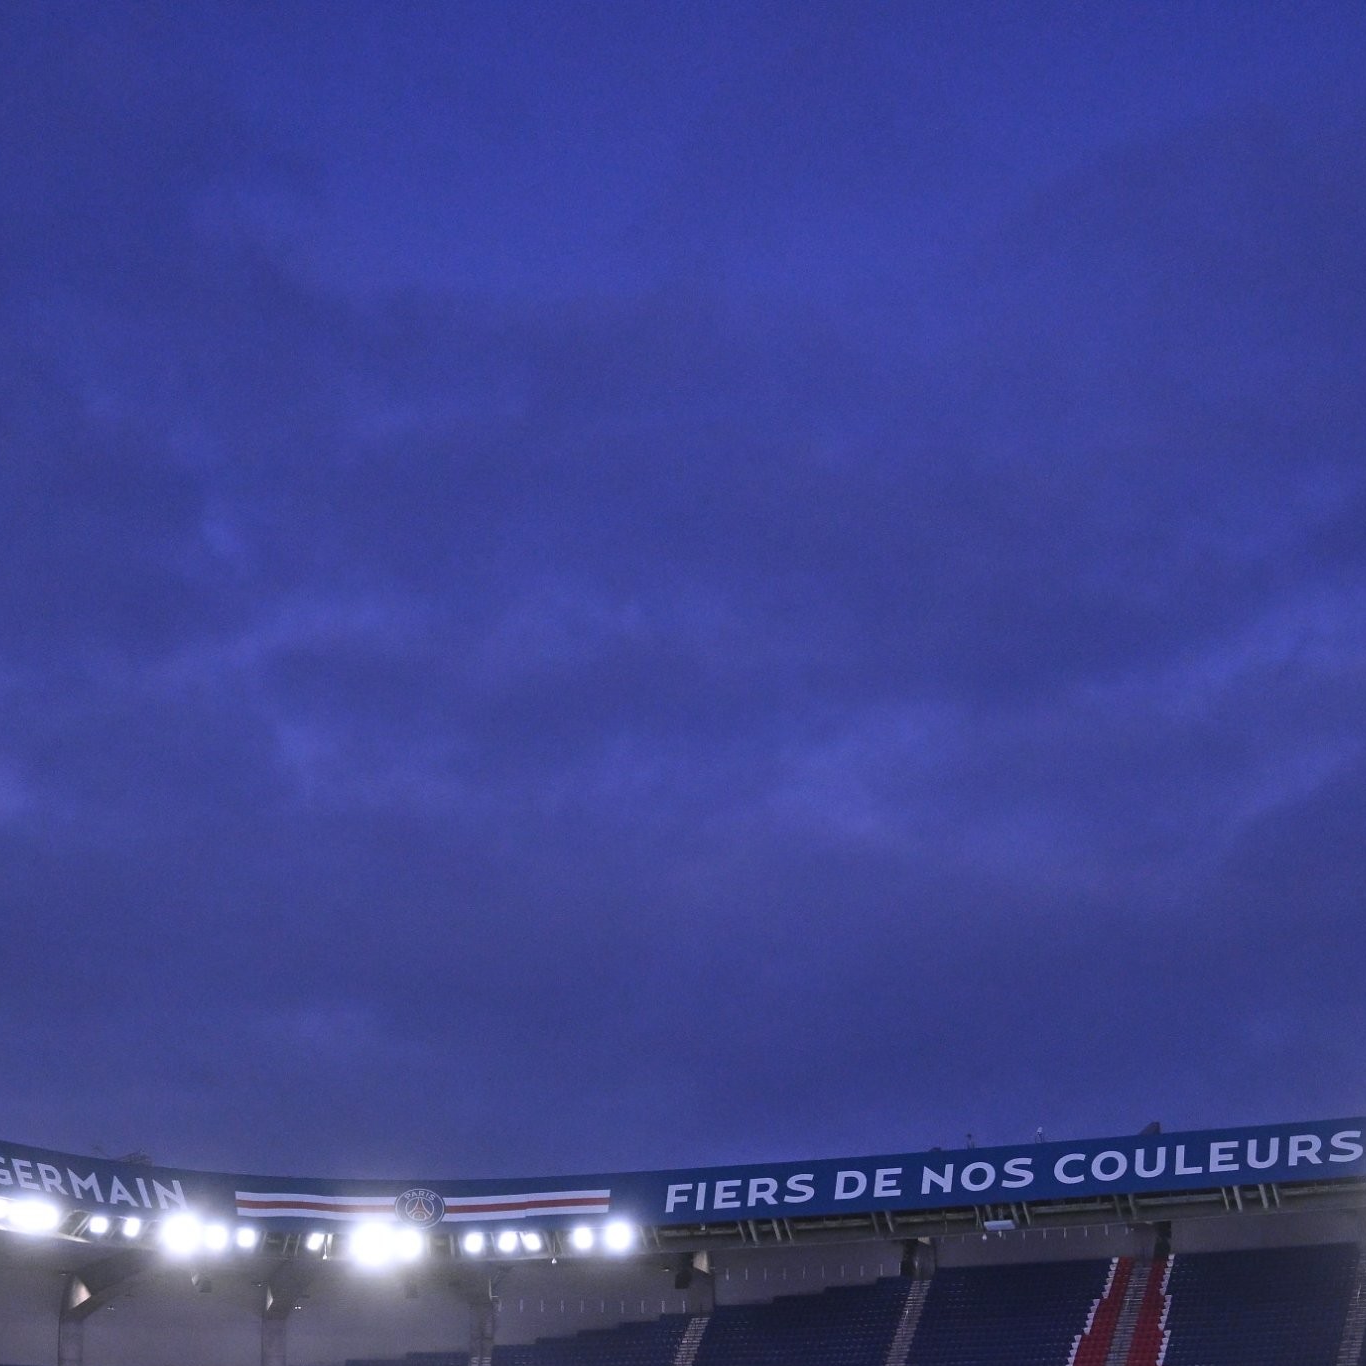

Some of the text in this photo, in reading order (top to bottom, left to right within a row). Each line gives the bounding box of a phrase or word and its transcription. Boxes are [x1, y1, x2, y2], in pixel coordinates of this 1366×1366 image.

[404, 1190, 436, 1201] PARIS
[664, 1129, 1365, 1214] FIERS DE NOS COULEURS
